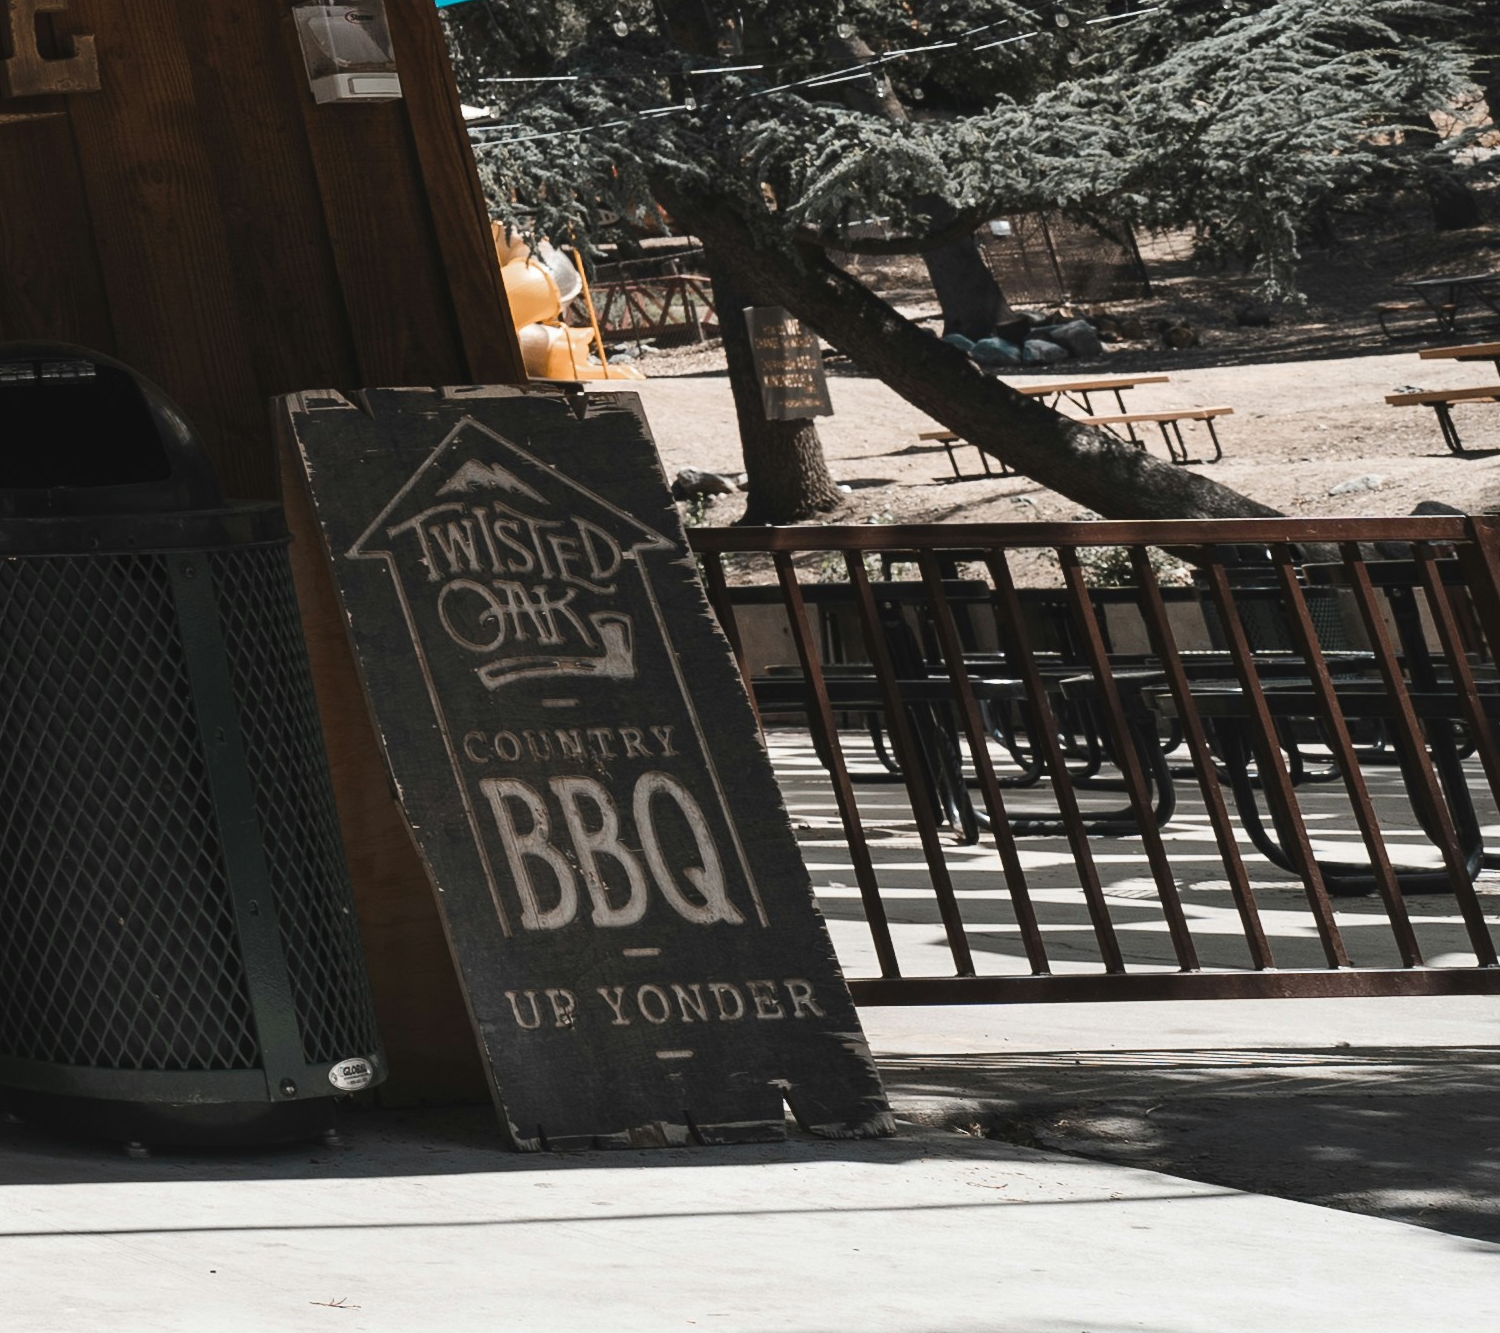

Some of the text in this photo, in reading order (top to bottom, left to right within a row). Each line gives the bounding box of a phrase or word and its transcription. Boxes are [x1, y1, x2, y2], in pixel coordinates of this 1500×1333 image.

[387, 503, 626, 593] TWISTED
[436, 577, 598, 653] OAK
[463, 724, 677, 763] COUNTRY
[479, 770, 747, 932] BBQ
[505, 978, 825, 1030] UP YONDER
